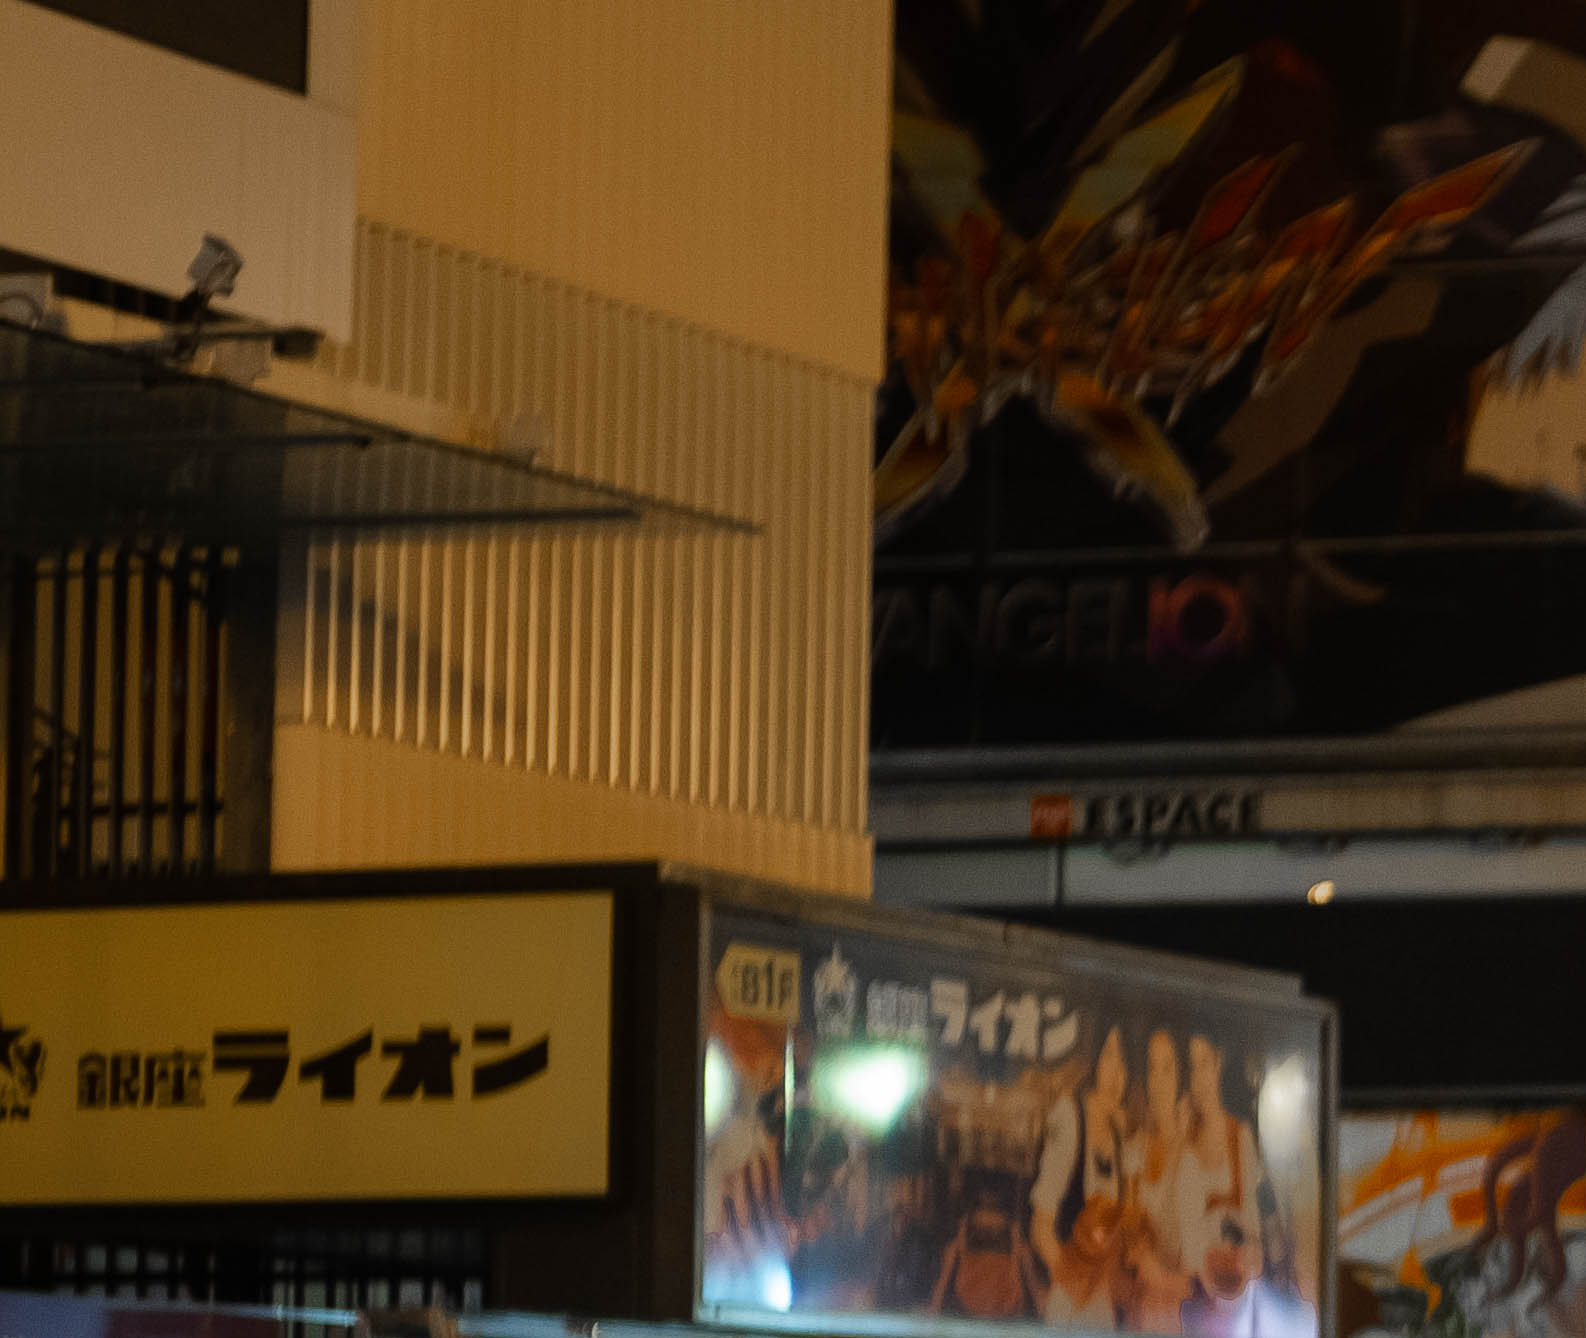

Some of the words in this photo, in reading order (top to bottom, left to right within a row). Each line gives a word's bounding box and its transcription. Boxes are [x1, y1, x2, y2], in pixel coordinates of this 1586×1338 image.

[76, 1025, 550, 1110] 銀座ライオン
